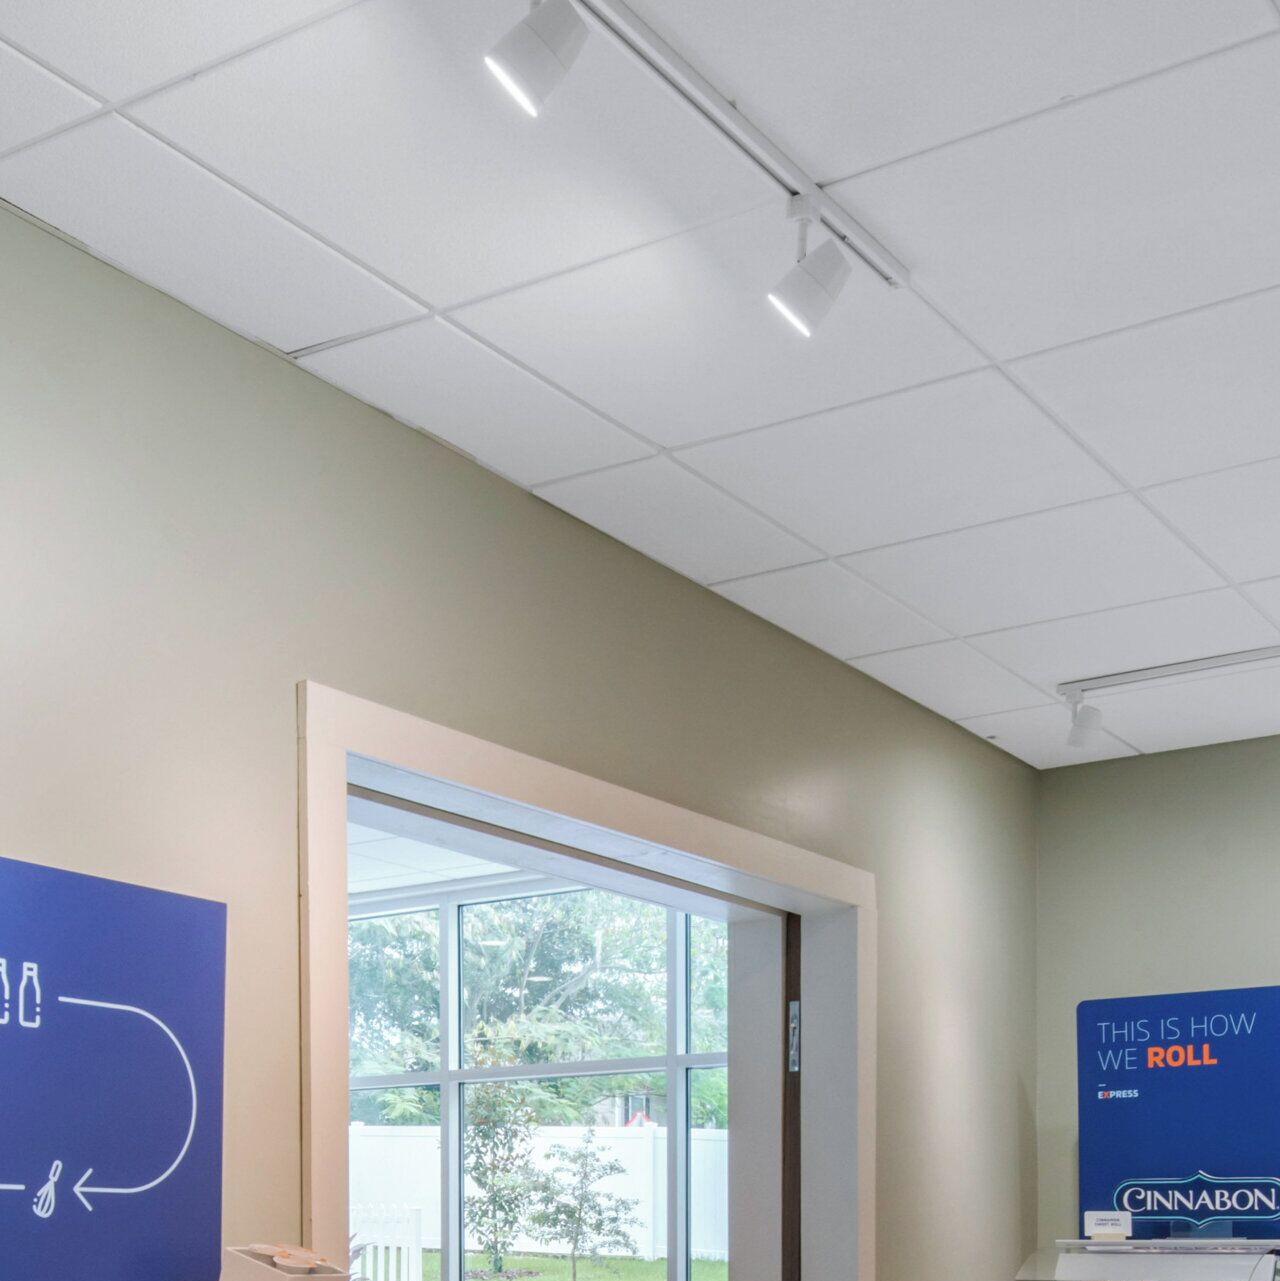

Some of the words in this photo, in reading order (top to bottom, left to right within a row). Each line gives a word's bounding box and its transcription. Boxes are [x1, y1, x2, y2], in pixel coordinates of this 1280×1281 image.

[1097, 1019, 1150, 1044] THIS
[1160, 1017, 1180, 1040] IS
[1190, 1012, 1257, 1038] HOW
[1097, 1048, 1138, 1071] WE
[1147, 1043, 1218, 1069] ROLL
[1097, 1089, 1139, 1100] EXPRESS
